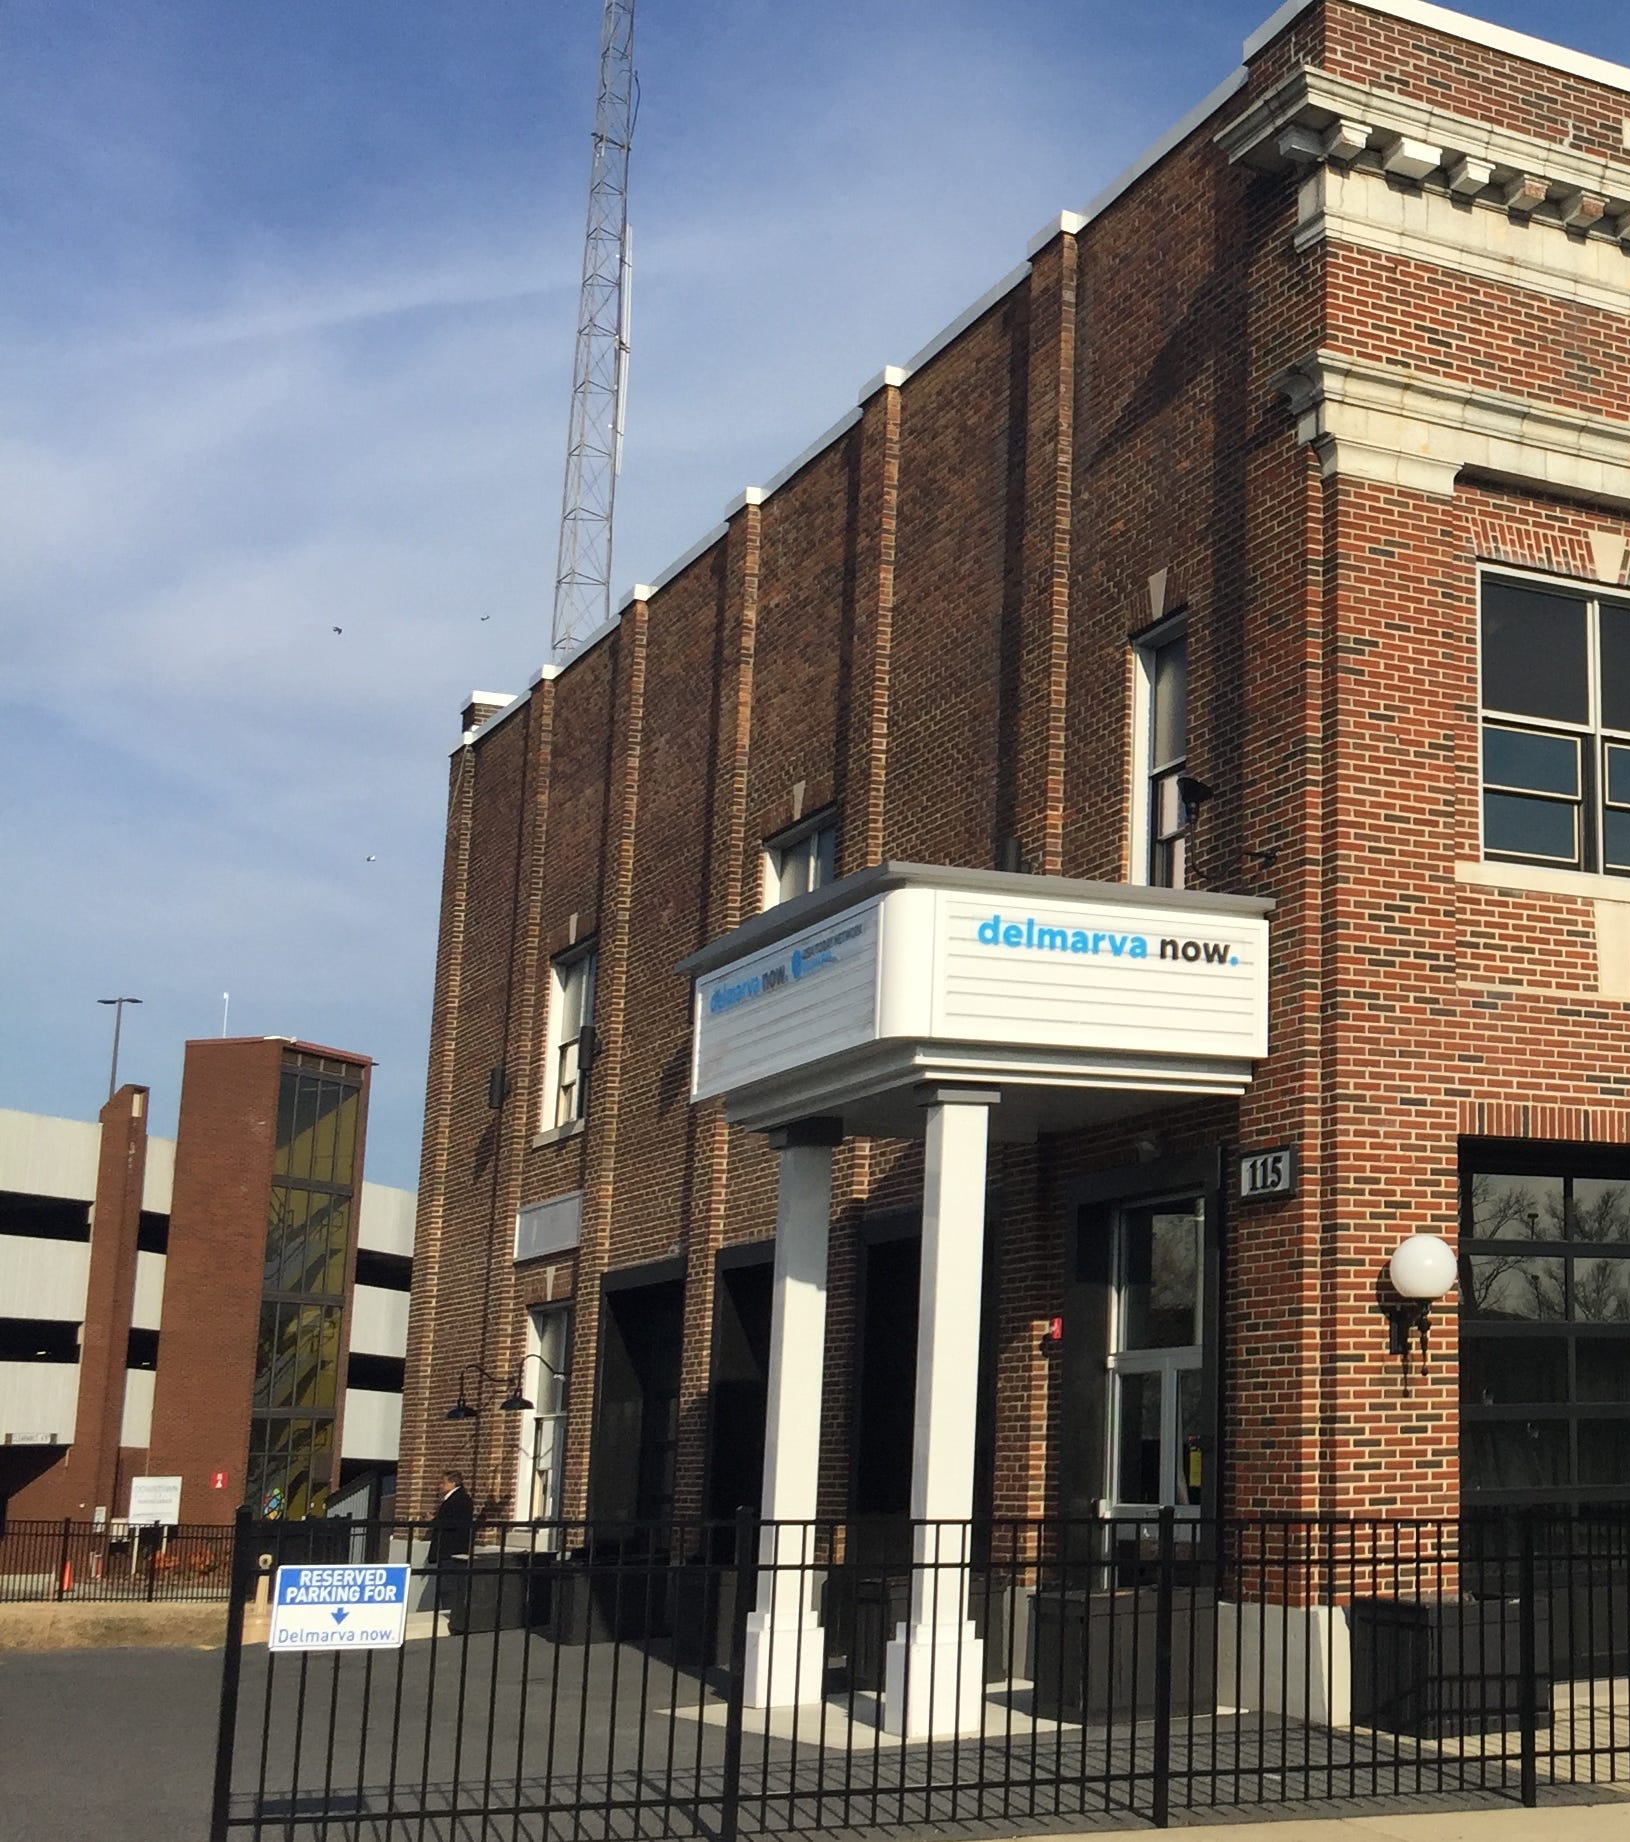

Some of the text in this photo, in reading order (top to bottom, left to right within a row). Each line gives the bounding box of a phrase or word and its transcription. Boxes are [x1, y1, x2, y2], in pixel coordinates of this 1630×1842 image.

[978, 914, 1239, 966] delmarva now.
[1250, 1155, 1282, 1191] 115
[300, 1569, 387, 1586] RESERVED
[286, 1585, 397, 1603] PARKING FOR
[278, 1628, 395, 1643] Delmarva now.
